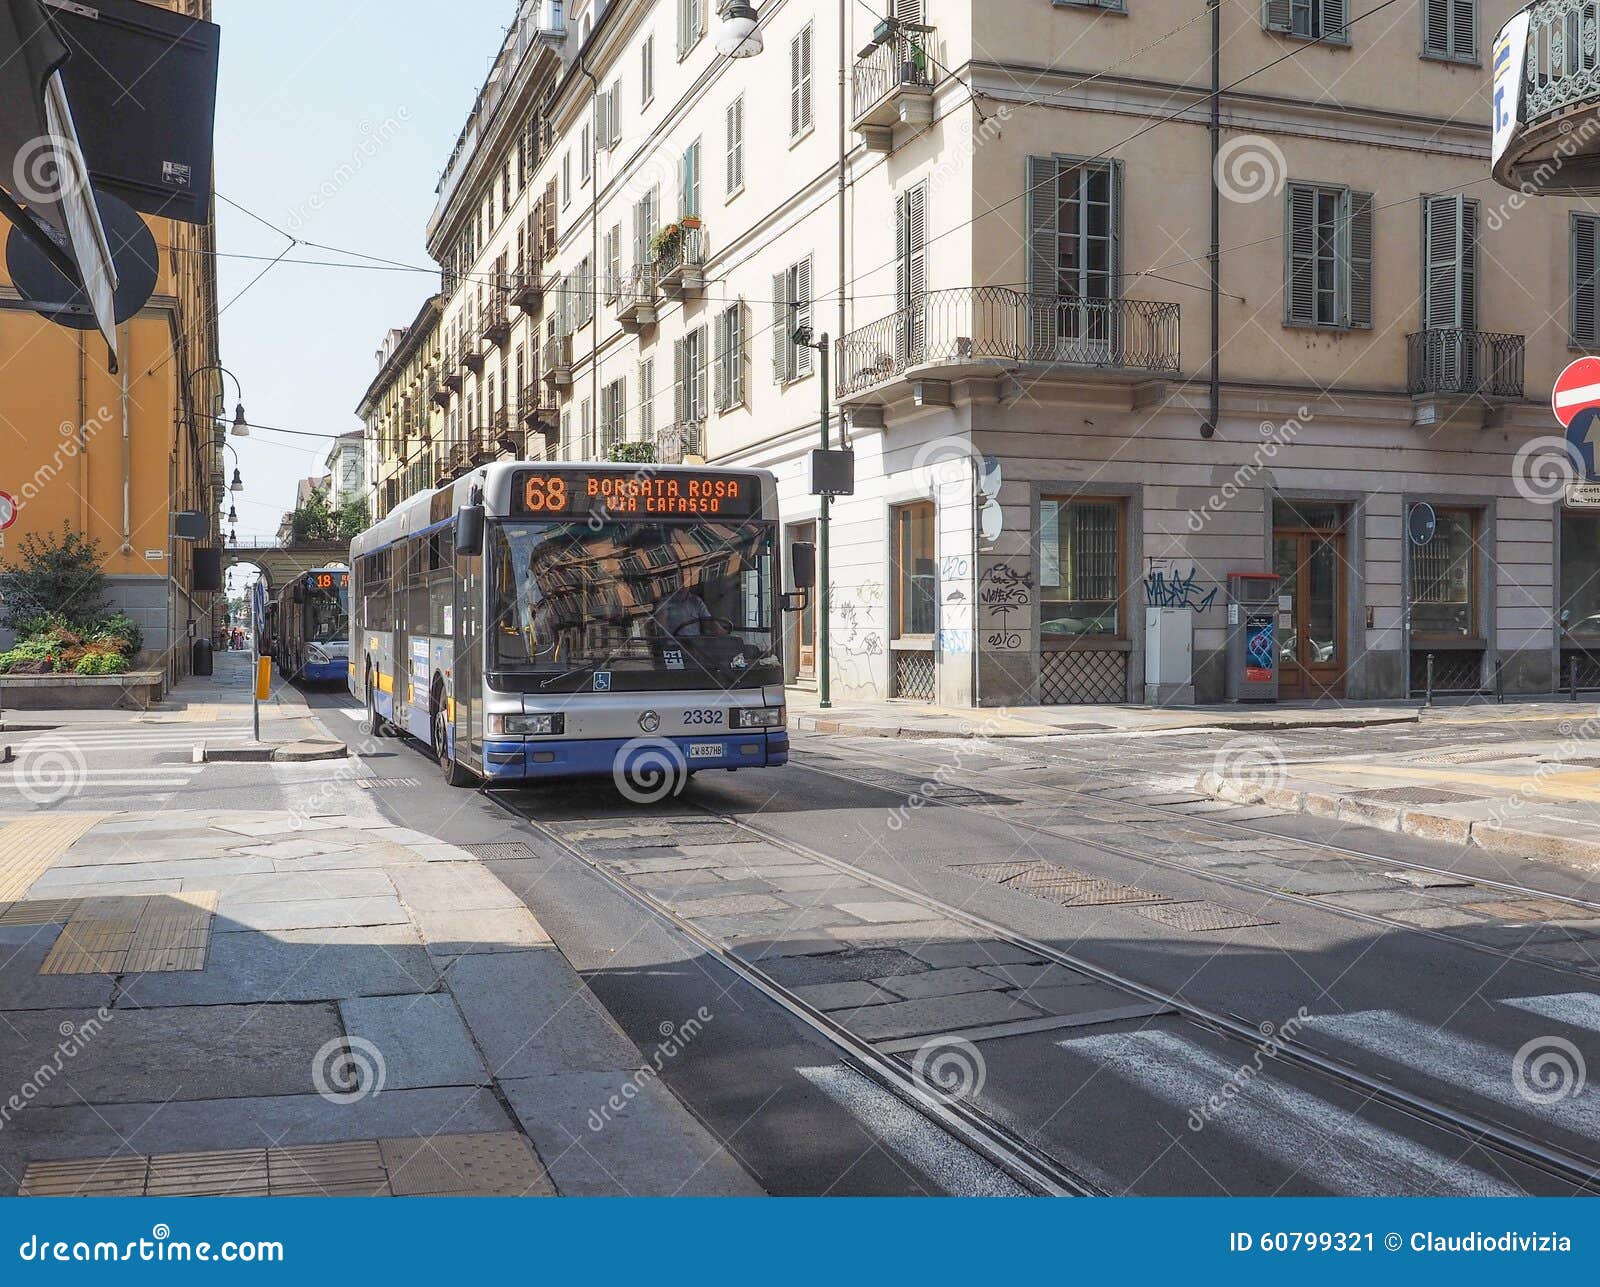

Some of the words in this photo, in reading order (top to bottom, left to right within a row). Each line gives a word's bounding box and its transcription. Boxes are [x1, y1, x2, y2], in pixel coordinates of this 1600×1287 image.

[526, 477, 567, 511] 68
[587, 478, 678, 496] BORGATA
[689, 480, 739, 497] ROSA
[606, 497, 637, 512] VIA
[646, 497, 719, 512] CAFASSO
[317, 574, 331, 587] 18
[683, 709, 723, 725] 2332
